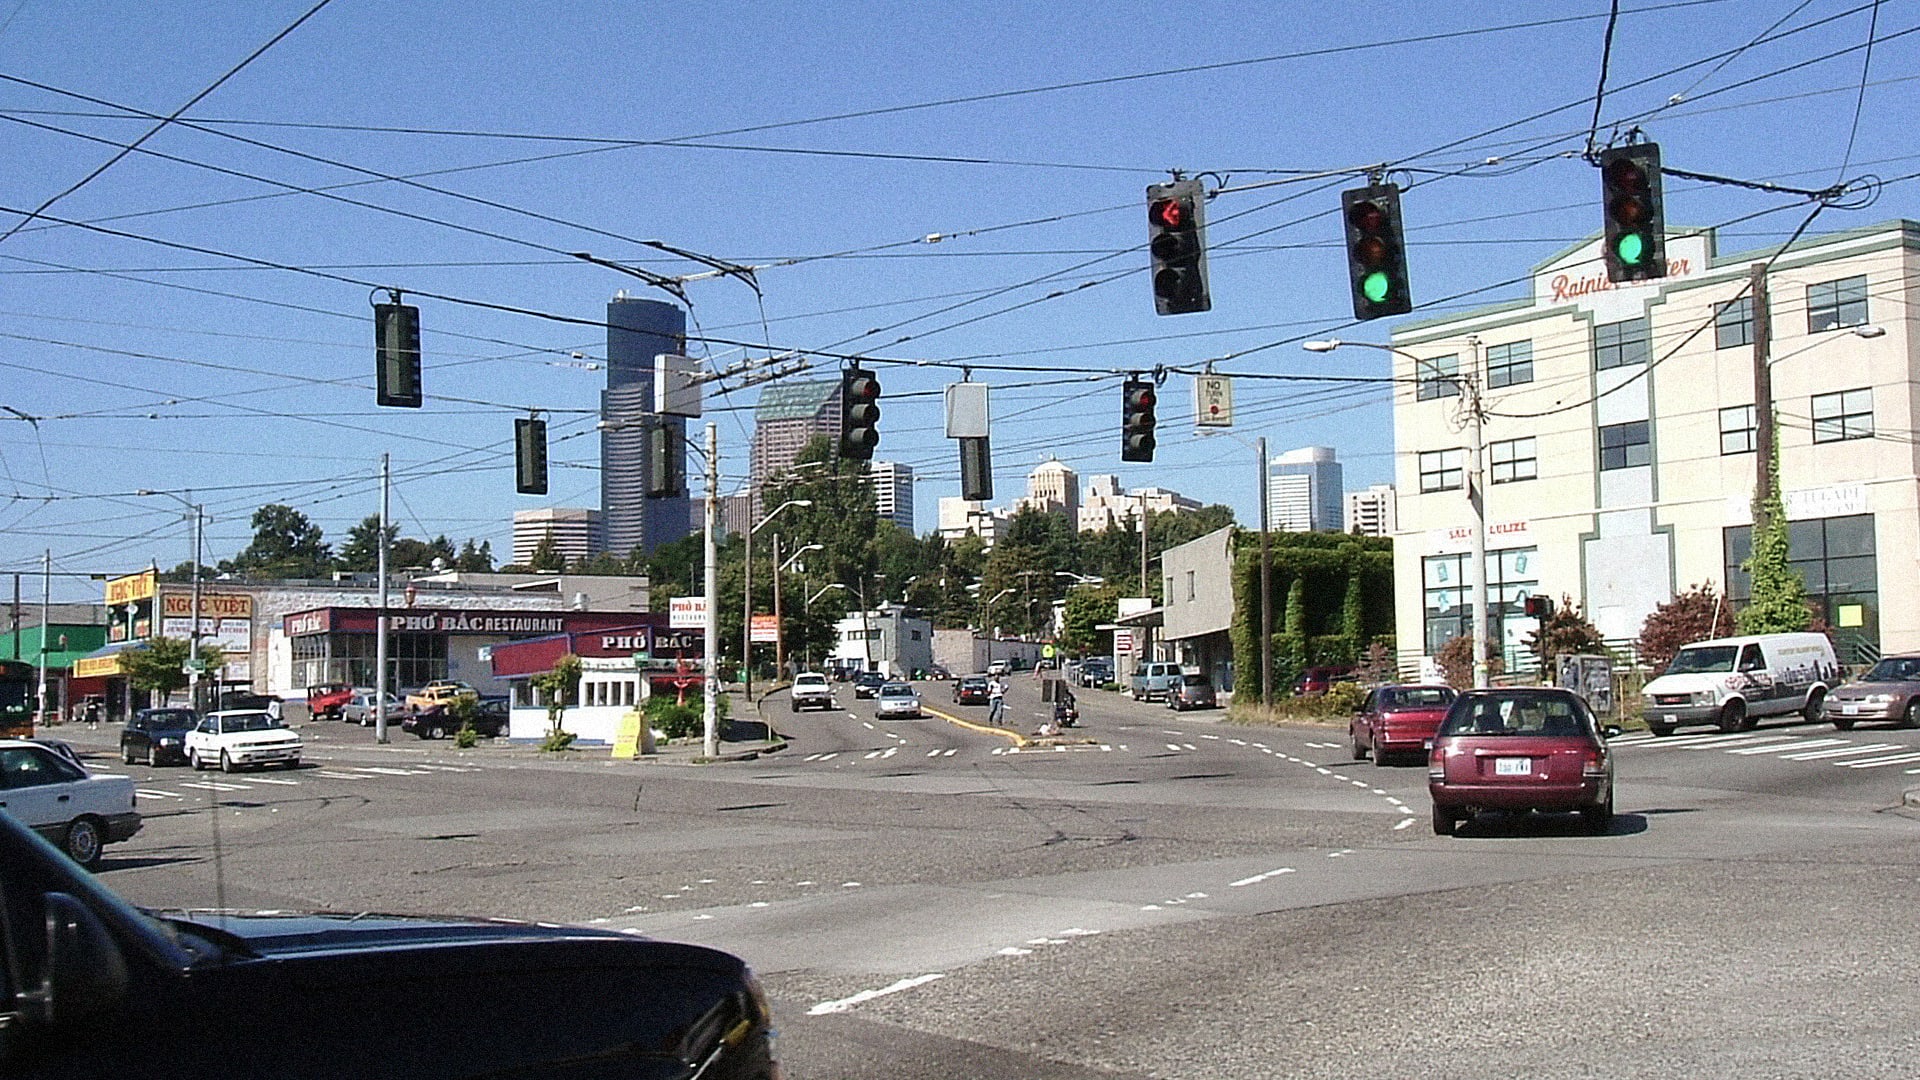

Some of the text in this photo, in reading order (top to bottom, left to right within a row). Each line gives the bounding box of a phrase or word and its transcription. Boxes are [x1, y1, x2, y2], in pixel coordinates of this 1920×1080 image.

[1552, 272, 1620, 302] Rainie
[1206, 381, 1221, 390] NO
[1449, 528, 1473, 539] SAL
[484, 617, 564, 632] RESTAURANT
